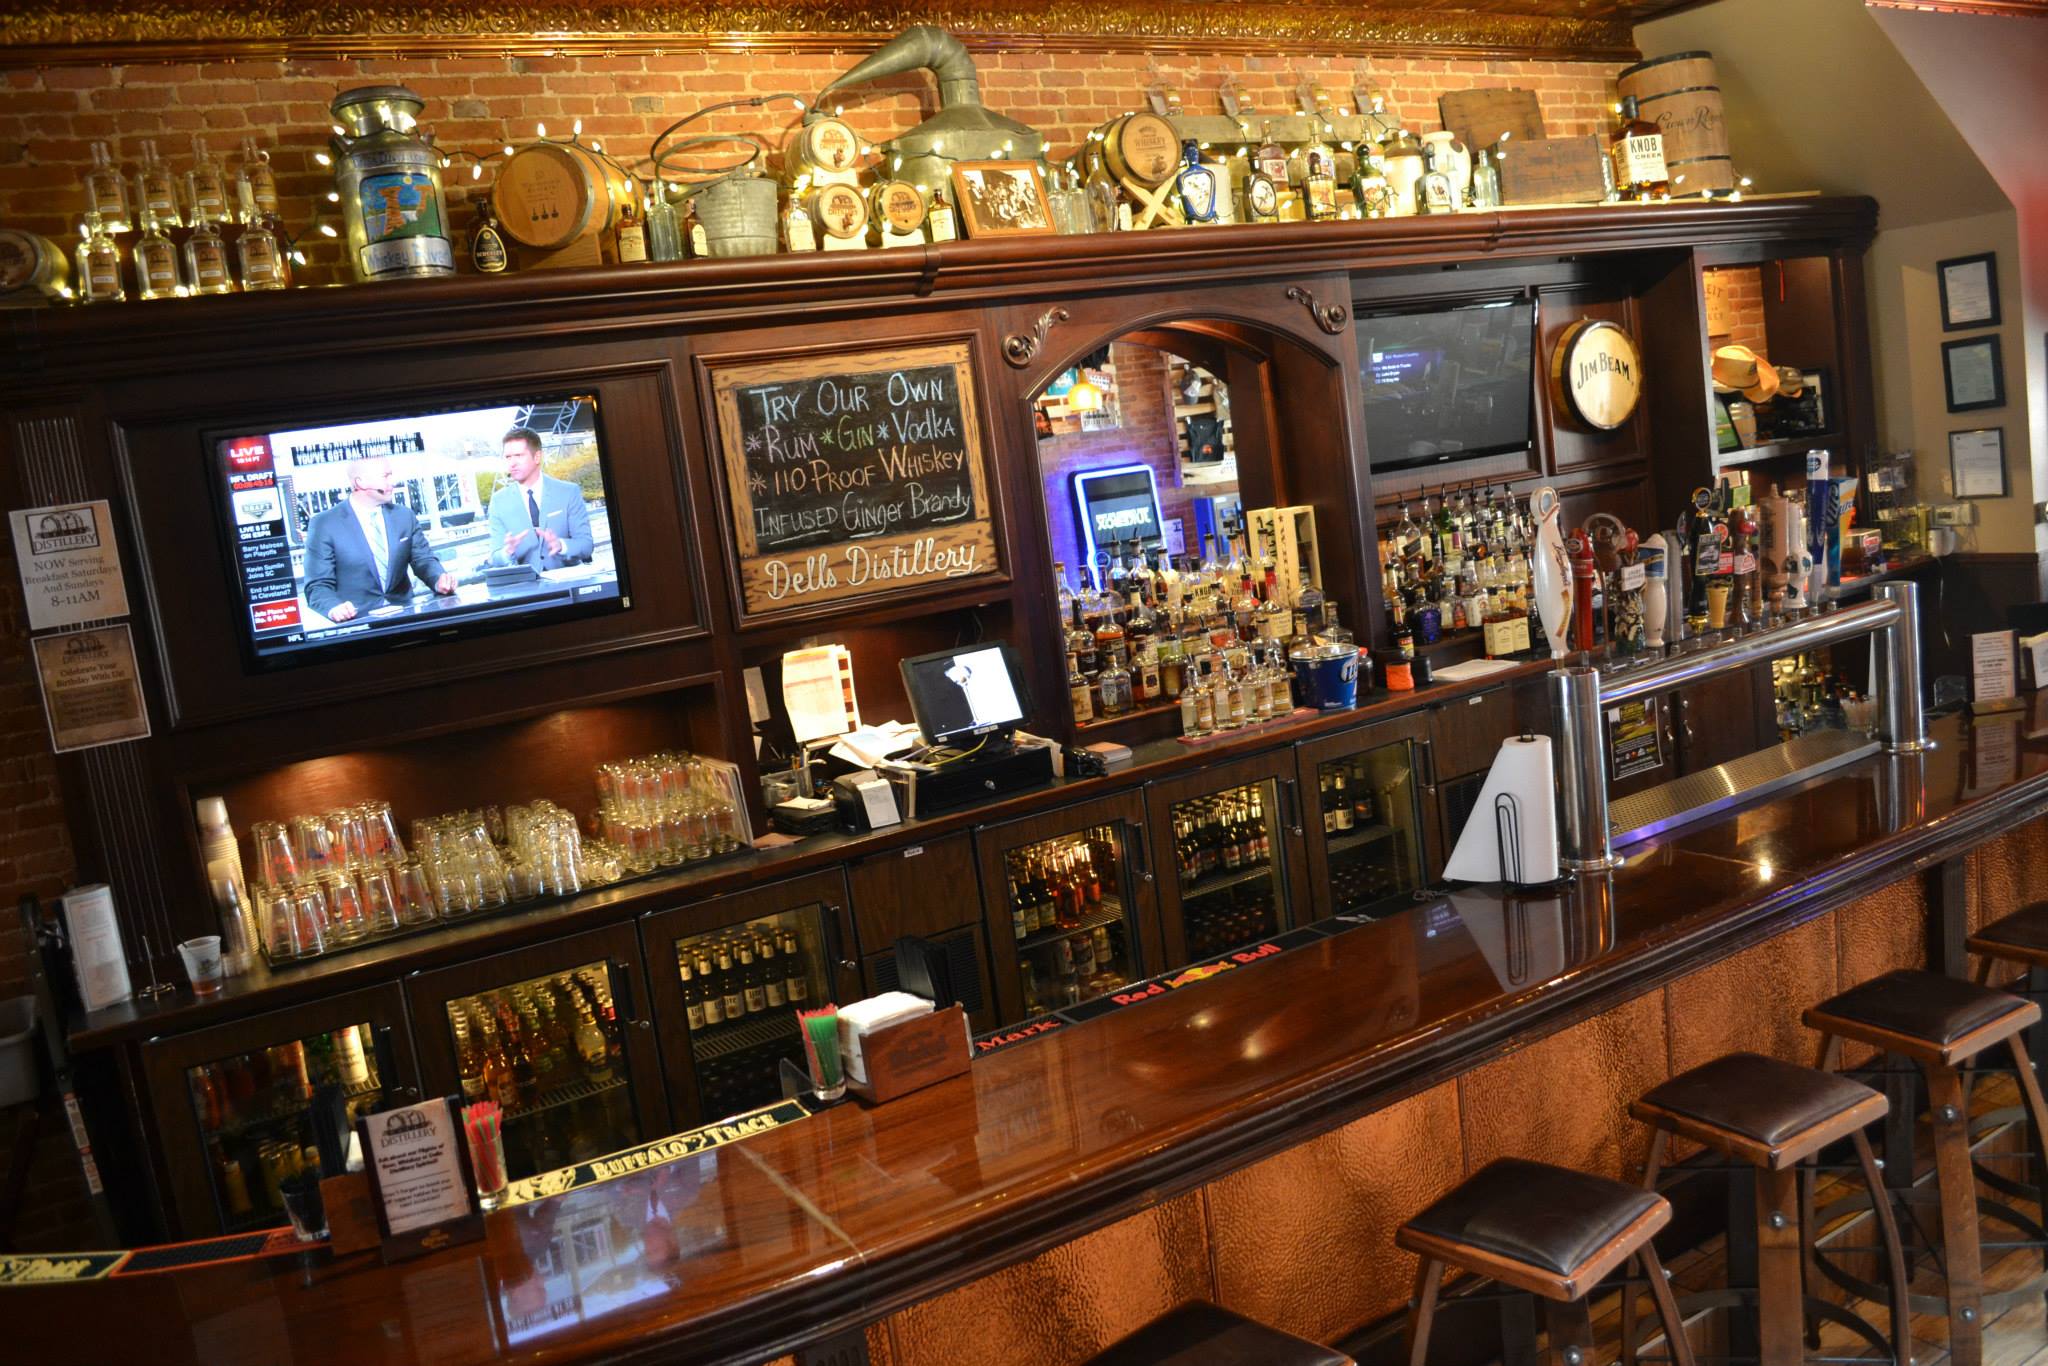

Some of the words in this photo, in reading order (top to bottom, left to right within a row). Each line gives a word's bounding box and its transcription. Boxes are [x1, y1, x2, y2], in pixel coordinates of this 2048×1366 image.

[1630, 137, 1657, 153] KNOB
[1577, 359, 1598, 390] JIM
[1599, 352, 1630, 381] BEAM
[749, 386, 801, 424] TRY
[817, 381, 870, 415] OUR
[887, 372, 944, 406] OWN
[230, 445, 264, 458] LIVE
[230, 475, 246, 484] NFL
[246, 471, 274, 482] DRAFT
[774, 467, 806, 495] 110
[809, 460, 877, 494] PROOF
[239, 525, 254, 533] LIVE
[755, 506, 839, 537] INFUSED
[33, 533, 97, 552] DISTILLERY
[252, 530, 272, 539] ESPN
[33, 559, 66, 572] NOW
[67, 556, 104, 568] Serving
[764, 554, 837, 600] Dells
[846, 537, 983, 586] Distillery
[24, 572, 69, 585] Breakfast
[71, 565, 118, 579] Saturdays
[42, 584, 63, 594] And
[64, 579, 104, 590] Sundays
[287, 634, 304, 643] NFL
[56, 676, 90, 688] Birthday
[1111, 983, 1166, 1007] Red
[1231, 943, 1283, 967] Bull
[975, 1019, 1063, 1052] Mark
[381, 1126, 437, 1148] DISTILLERY
[588, 1142, 690, 1181] BUFFALO
[709, 1112, 780, 1146] TRACE
